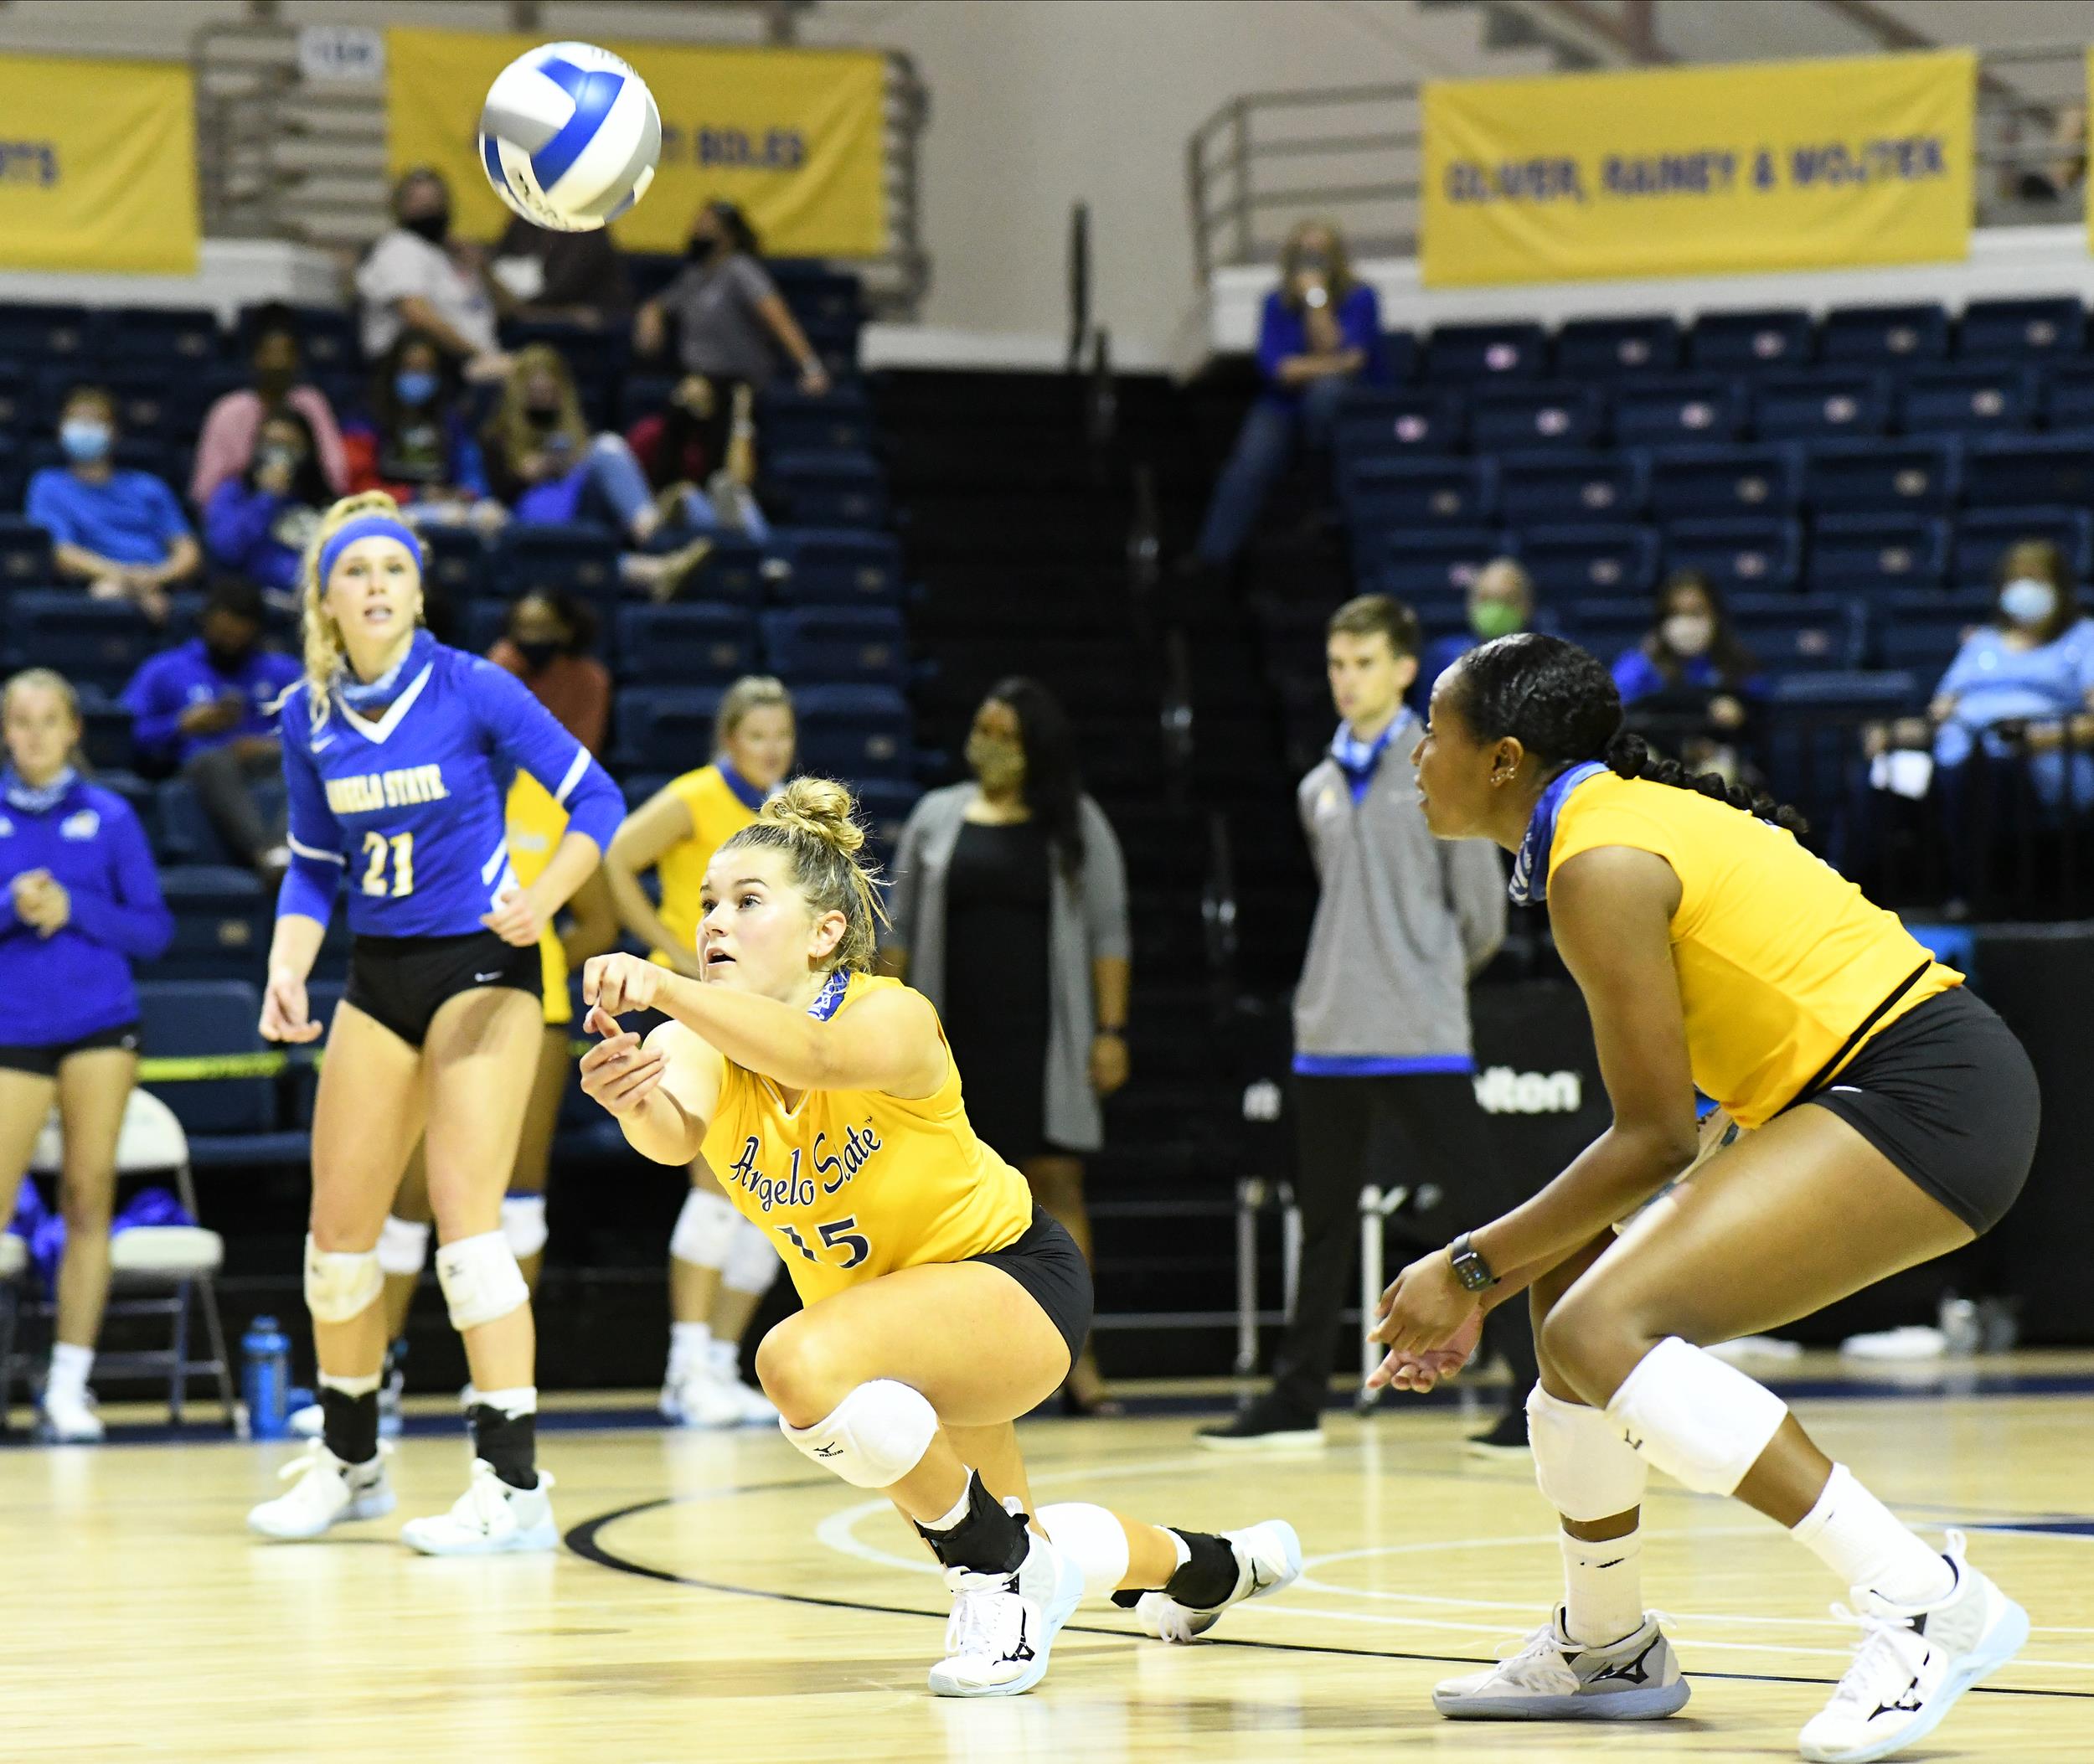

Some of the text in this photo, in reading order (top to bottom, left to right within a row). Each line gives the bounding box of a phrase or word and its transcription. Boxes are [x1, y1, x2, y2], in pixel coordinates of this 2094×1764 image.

[383, 763, 447, 807] STATE
[362, 831, 414, 897] 21
[729, 1135, 816, 1212] Angelo
[775, 1215, 870, 1269] 15
